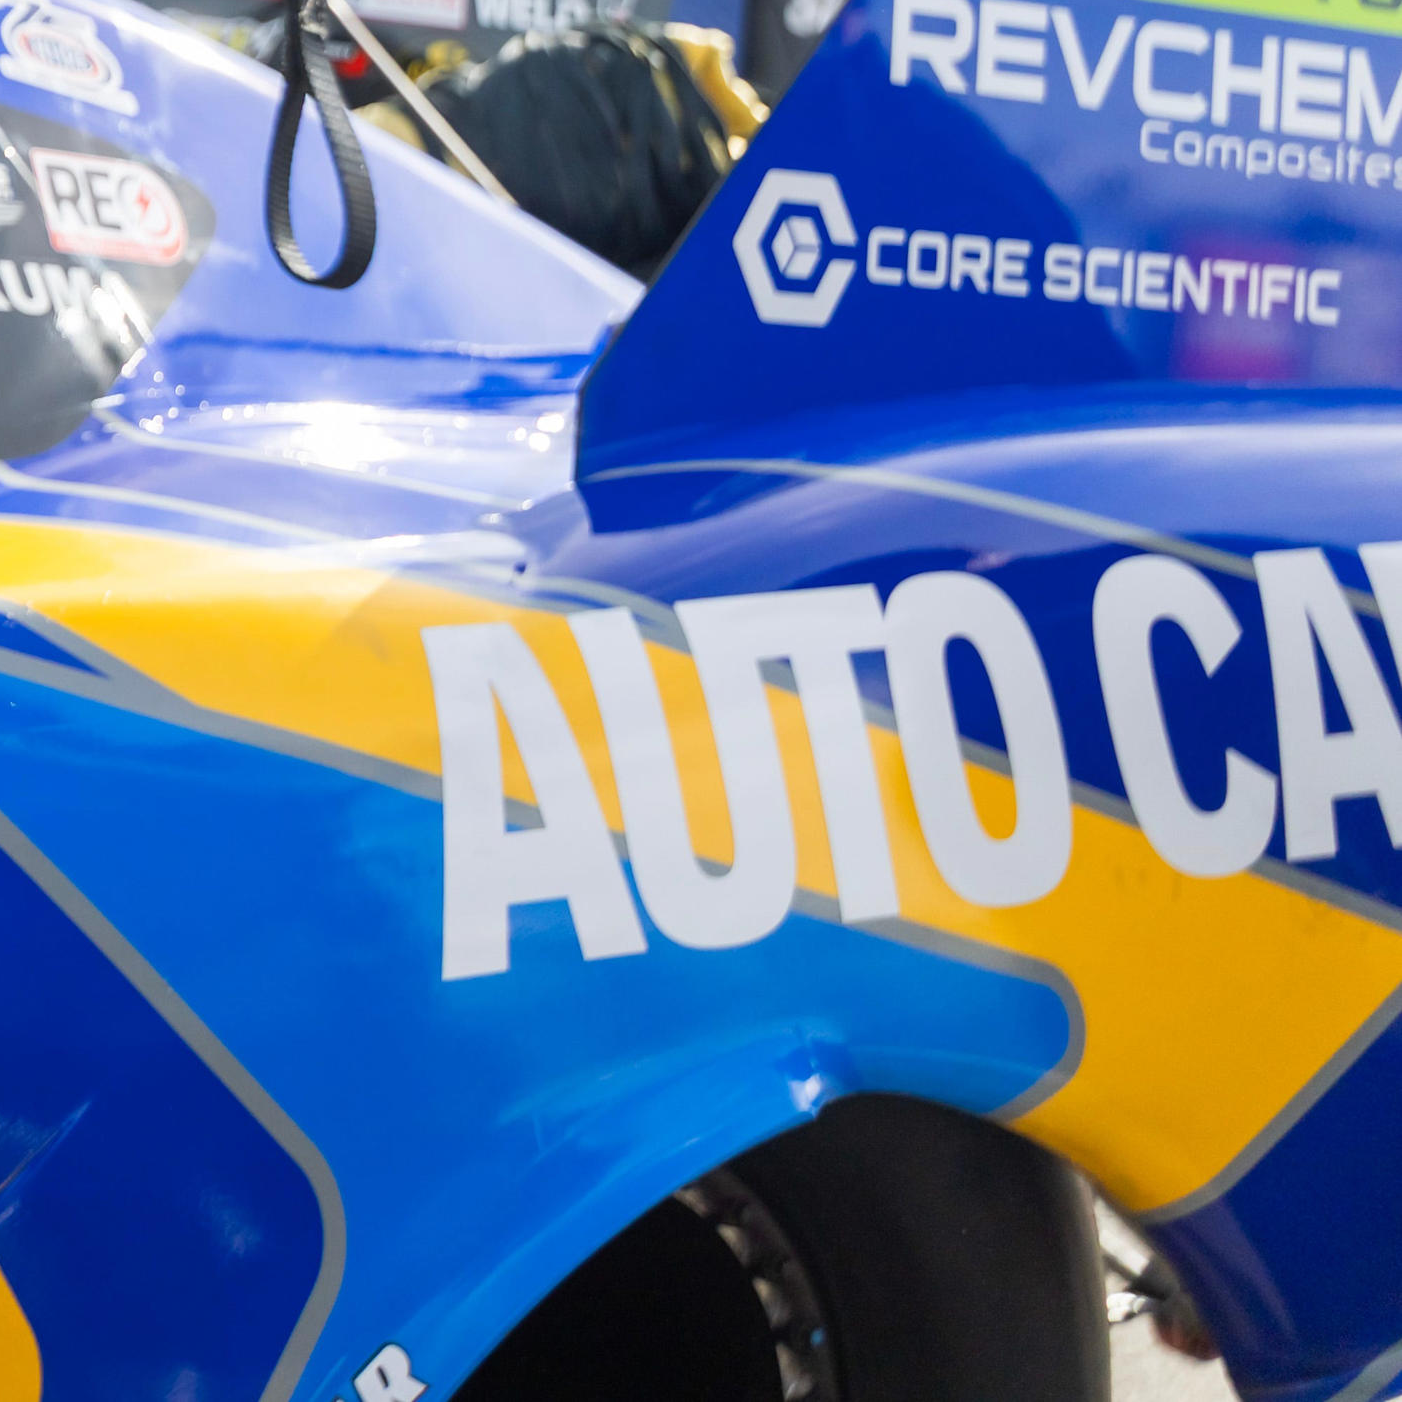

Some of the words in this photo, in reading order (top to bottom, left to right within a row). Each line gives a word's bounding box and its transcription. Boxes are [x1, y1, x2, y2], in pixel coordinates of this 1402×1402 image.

[865, 227, 1033, 296] CORE
[1043, 245, 1342, 327] SCIENTIFIC
[421, 570, 1075, 981] AUTO
[1092, 540, 1402, 880] CA
